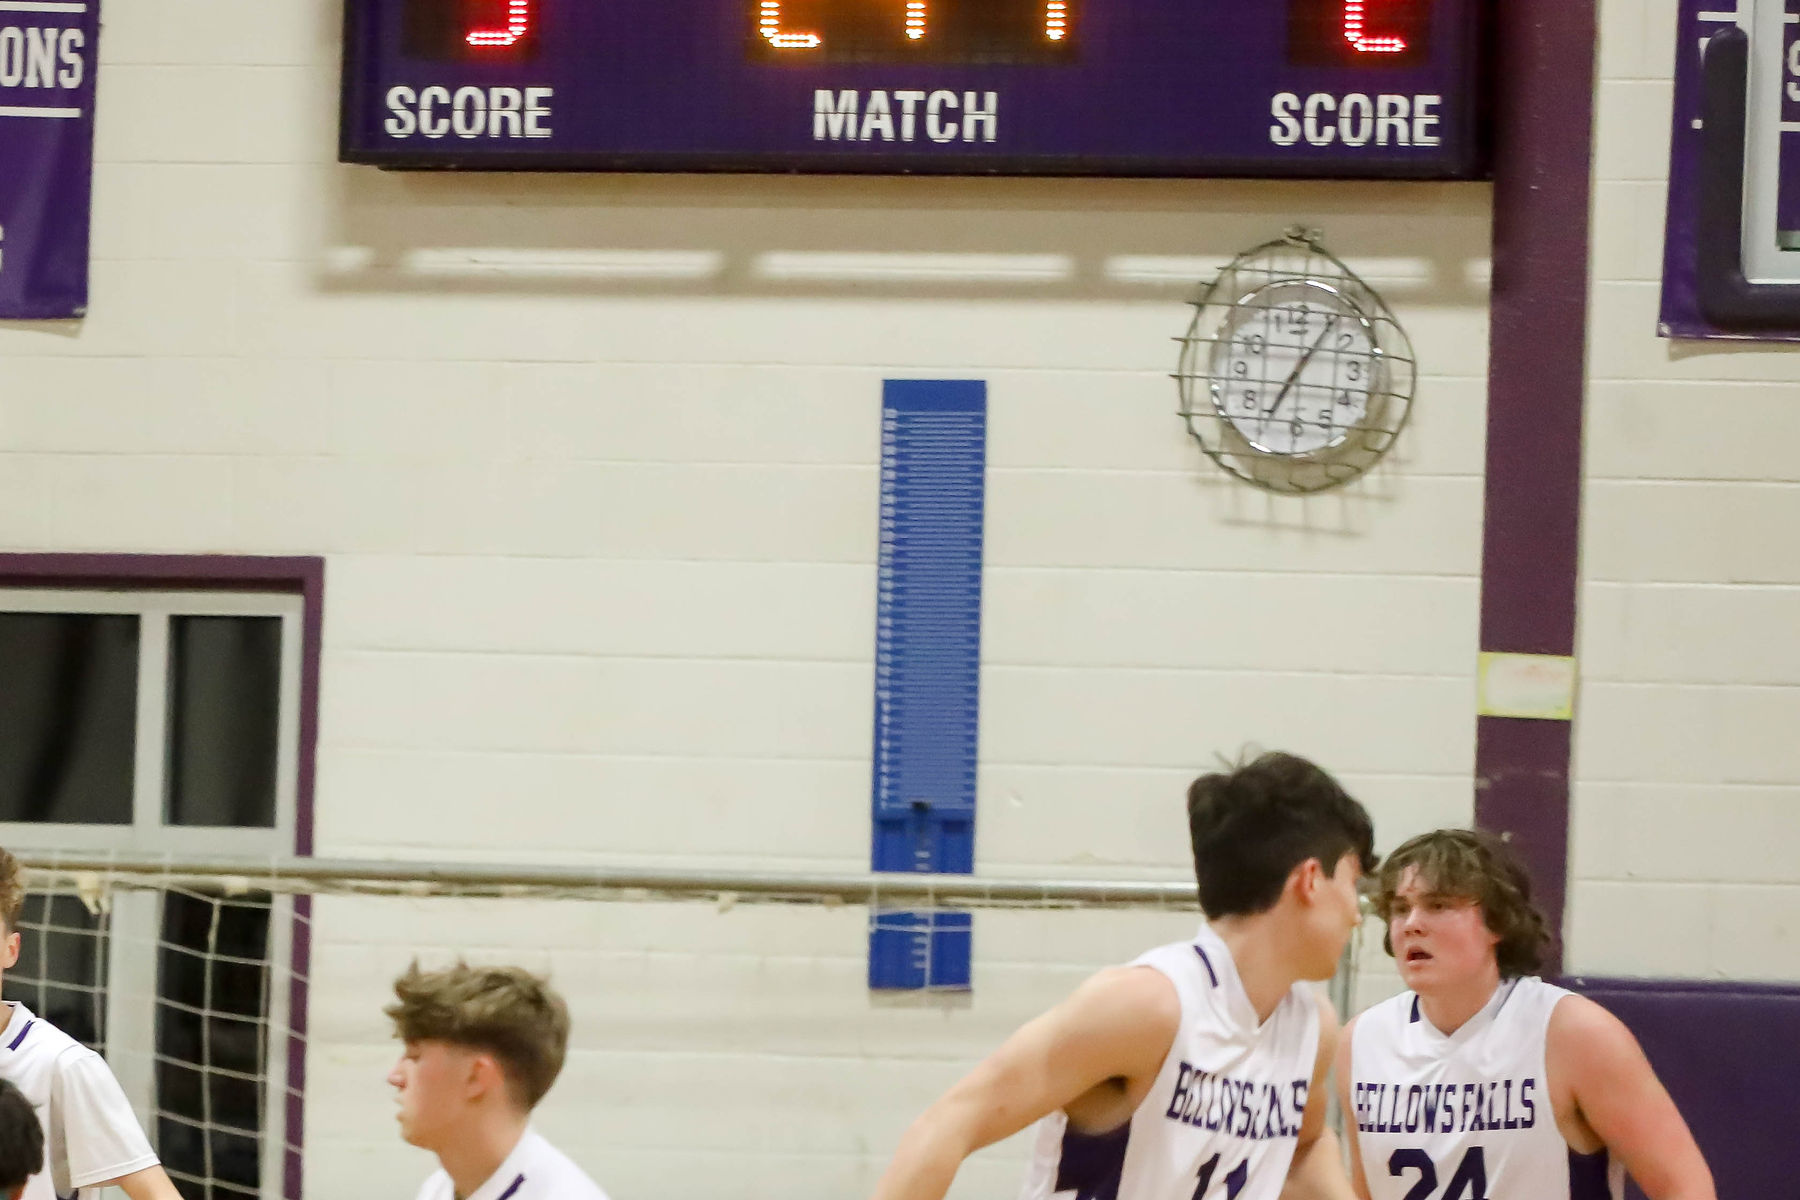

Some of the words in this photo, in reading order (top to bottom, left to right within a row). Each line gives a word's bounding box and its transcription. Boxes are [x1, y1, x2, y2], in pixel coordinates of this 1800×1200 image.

[384, 85, 554, 139] SCORE
[813, 89, 998, 143] MATCH
[1269, 92, 1442, 147] SCORE
[1347, 360, 1361, 382] 3
[1242, 389, 1257, 410] 8
